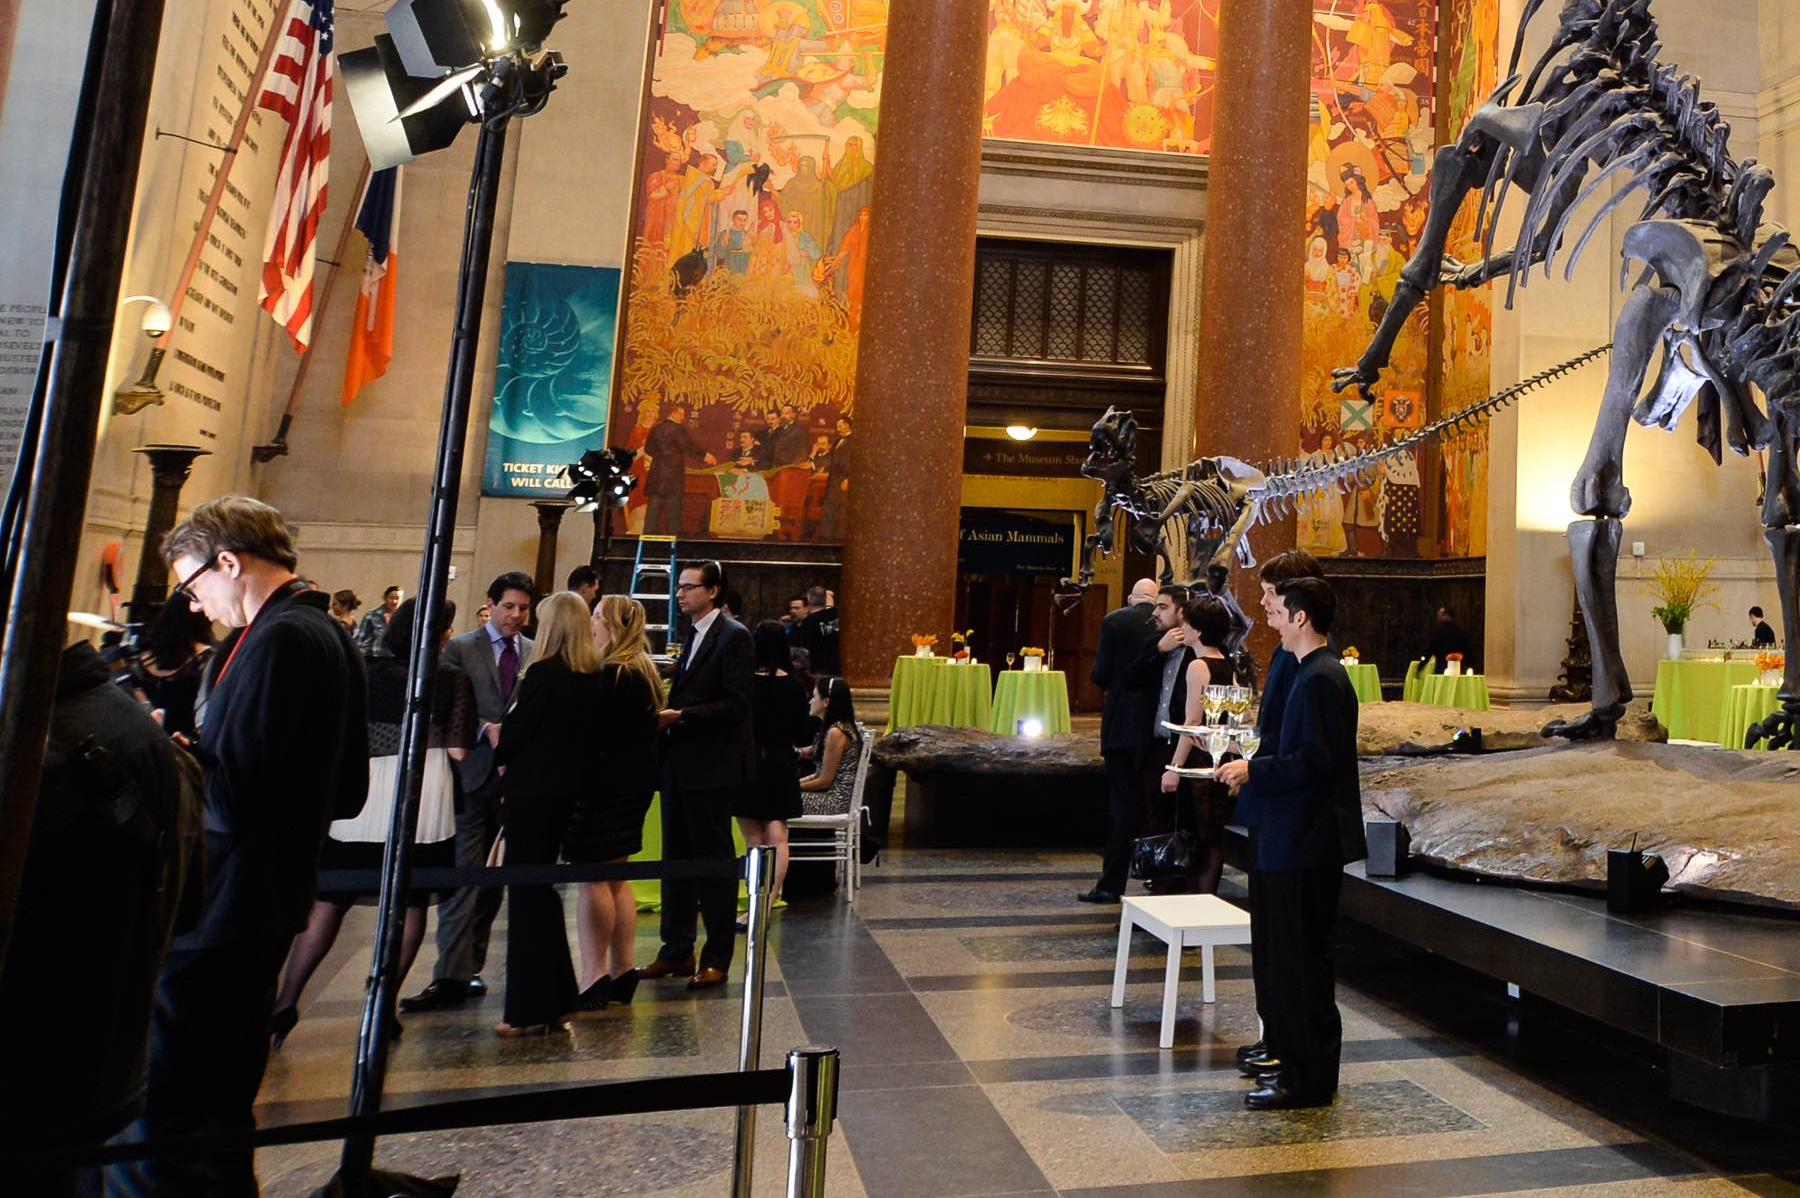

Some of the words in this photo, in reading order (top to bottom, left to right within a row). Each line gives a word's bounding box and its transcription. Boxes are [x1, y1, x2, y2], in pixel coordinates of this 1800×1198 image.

[994, 452, 1015, 464] The
[1017, 453, 1062, 465] Museum
[502, 462, 545, 474] TICKET
[511, 477, 541, 488] WILL
[544, 478, 572, 489] CALL
[968, 529, 1003, 542] Asian
[1006, 530, 1064, 544] Mammals
